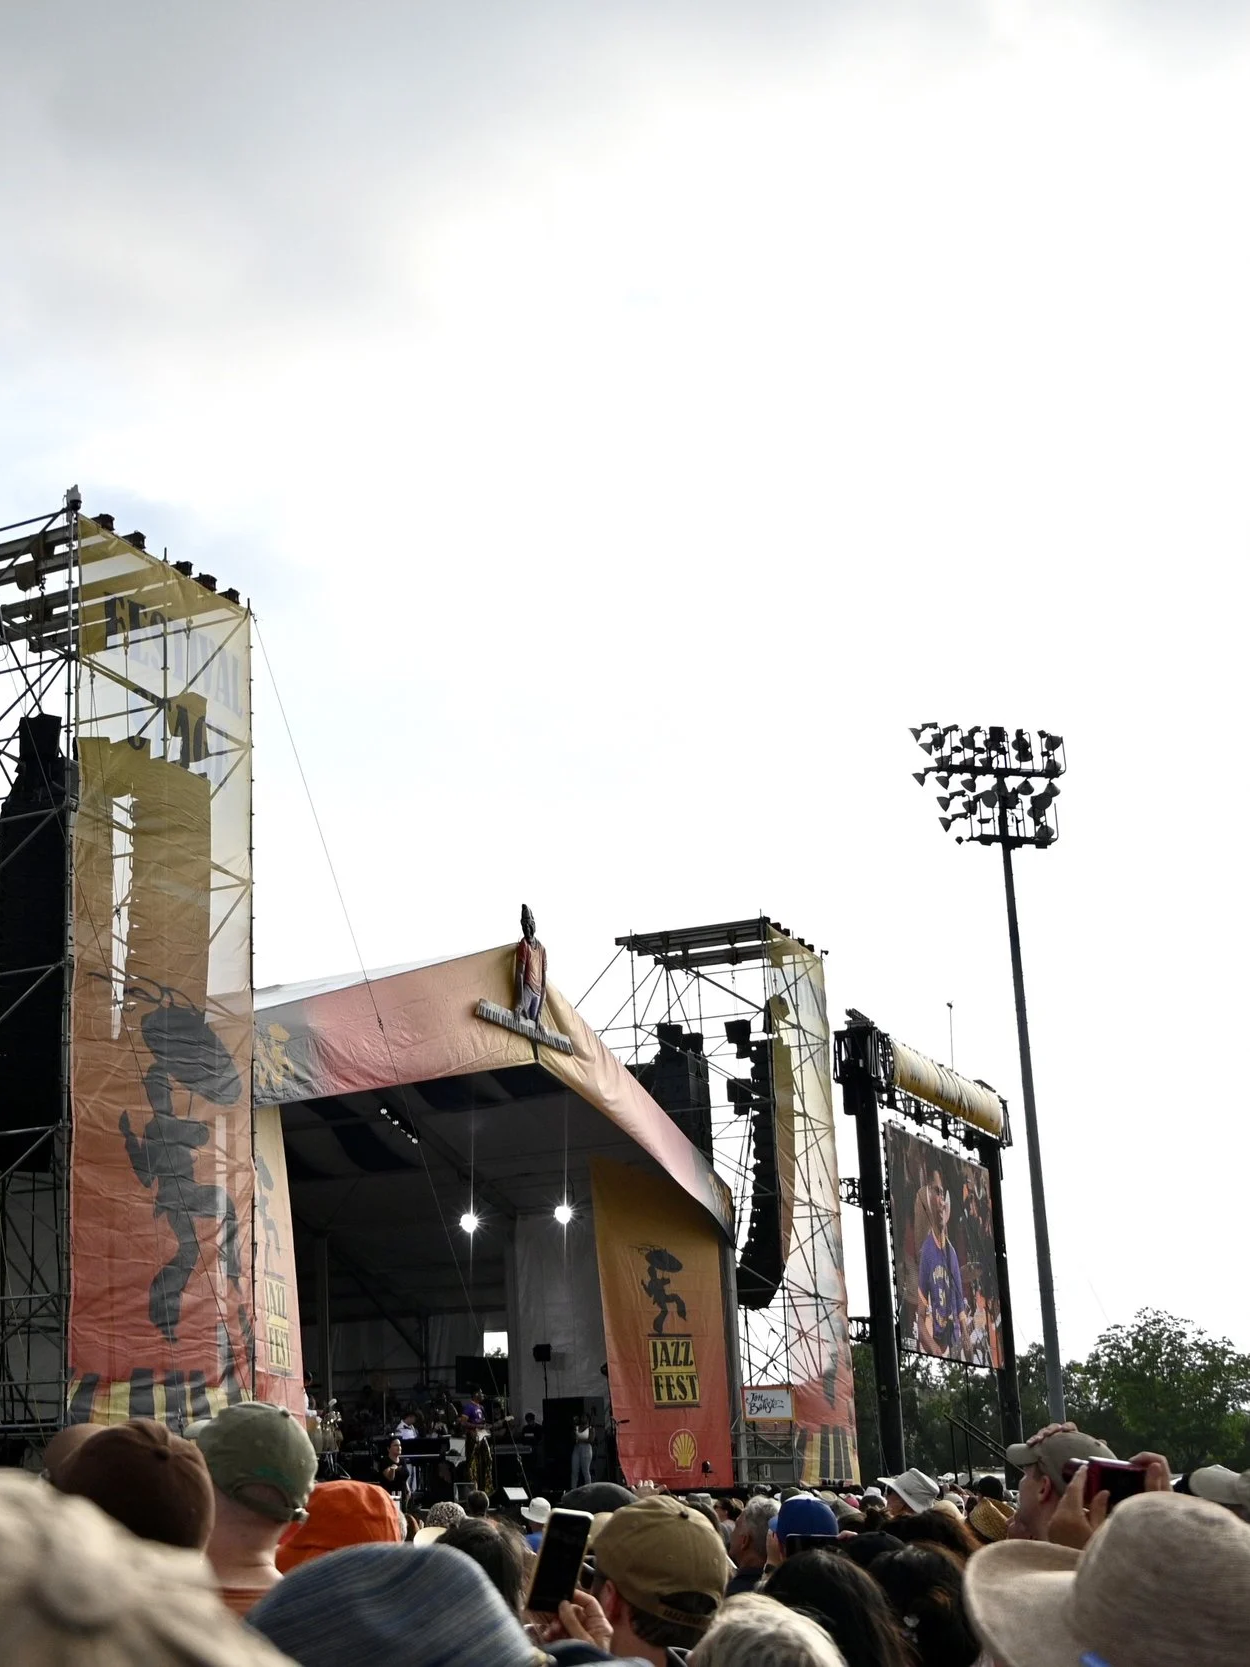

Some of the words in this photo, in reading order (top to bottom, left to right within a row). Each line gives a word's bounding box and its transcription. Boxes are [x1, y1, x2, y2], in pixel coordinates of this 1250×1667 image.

[104, 592, 243, 719] FESTIVAL
[264, 1280, 287, 1319] JAZZ
[269, 1327, 291, 1368] FEST
[652, 1341, 694, 1371] JAZZ
[654, 1375, 698, 1401] FEST
